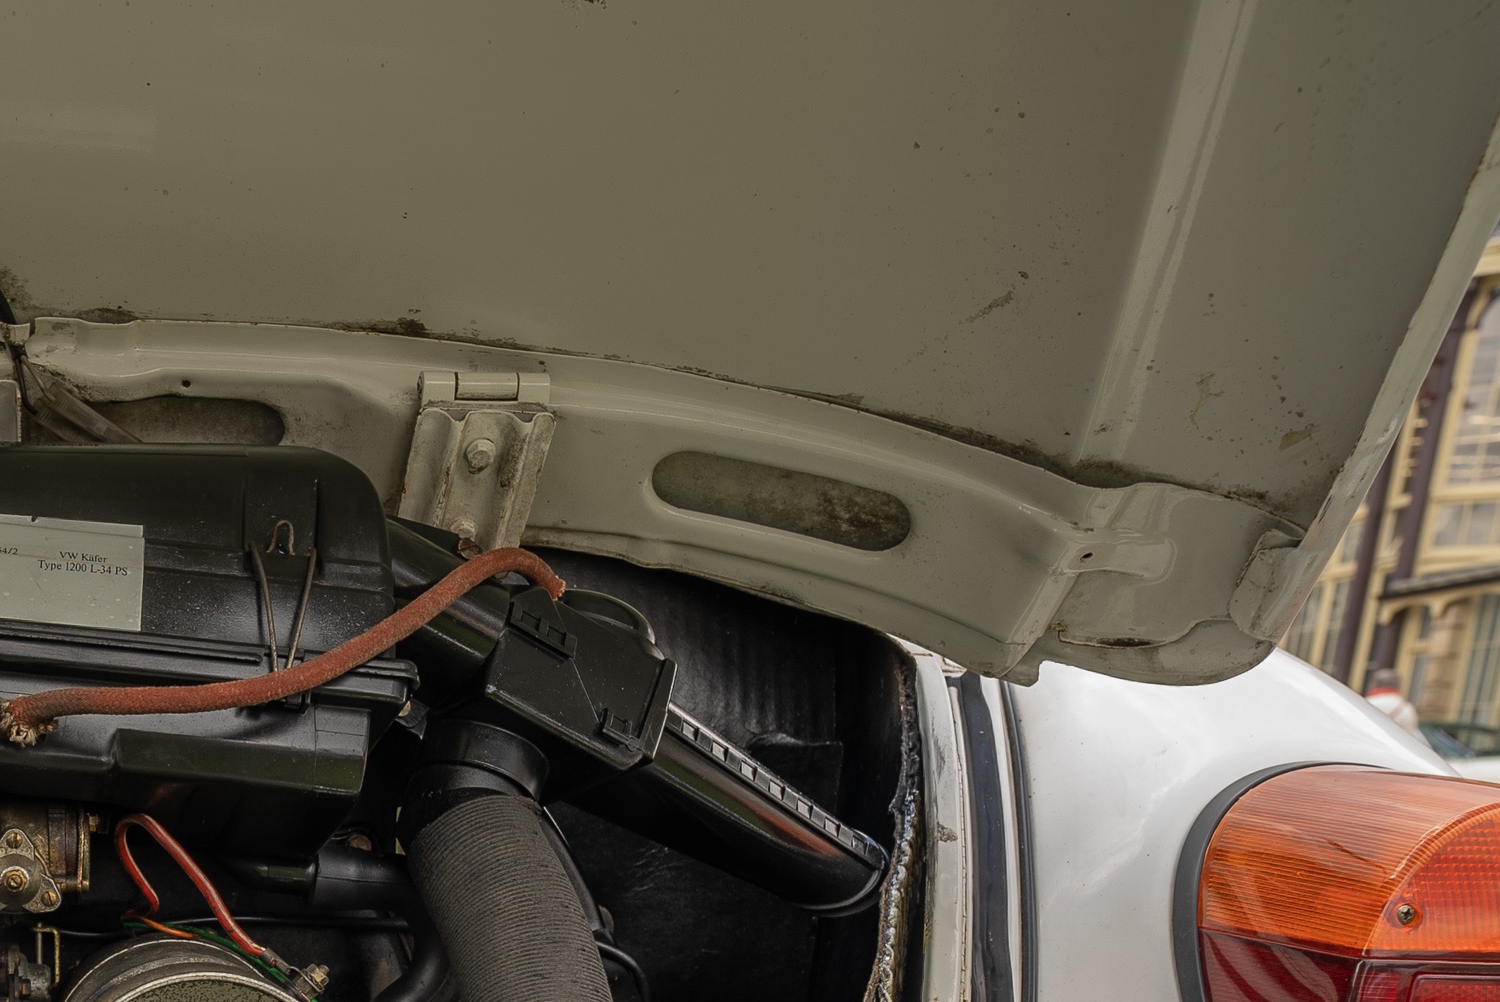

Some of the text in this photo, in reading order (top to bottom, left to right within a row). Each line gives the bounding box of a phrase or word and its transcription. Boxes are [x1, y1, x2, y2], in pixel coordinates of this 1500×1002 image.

[59, 550, 108, 564] VW Käfer
[37, 559, 62, 572] Type
[65, 561, 87, 573] 1200
[115, 565, 128, 577] PS
